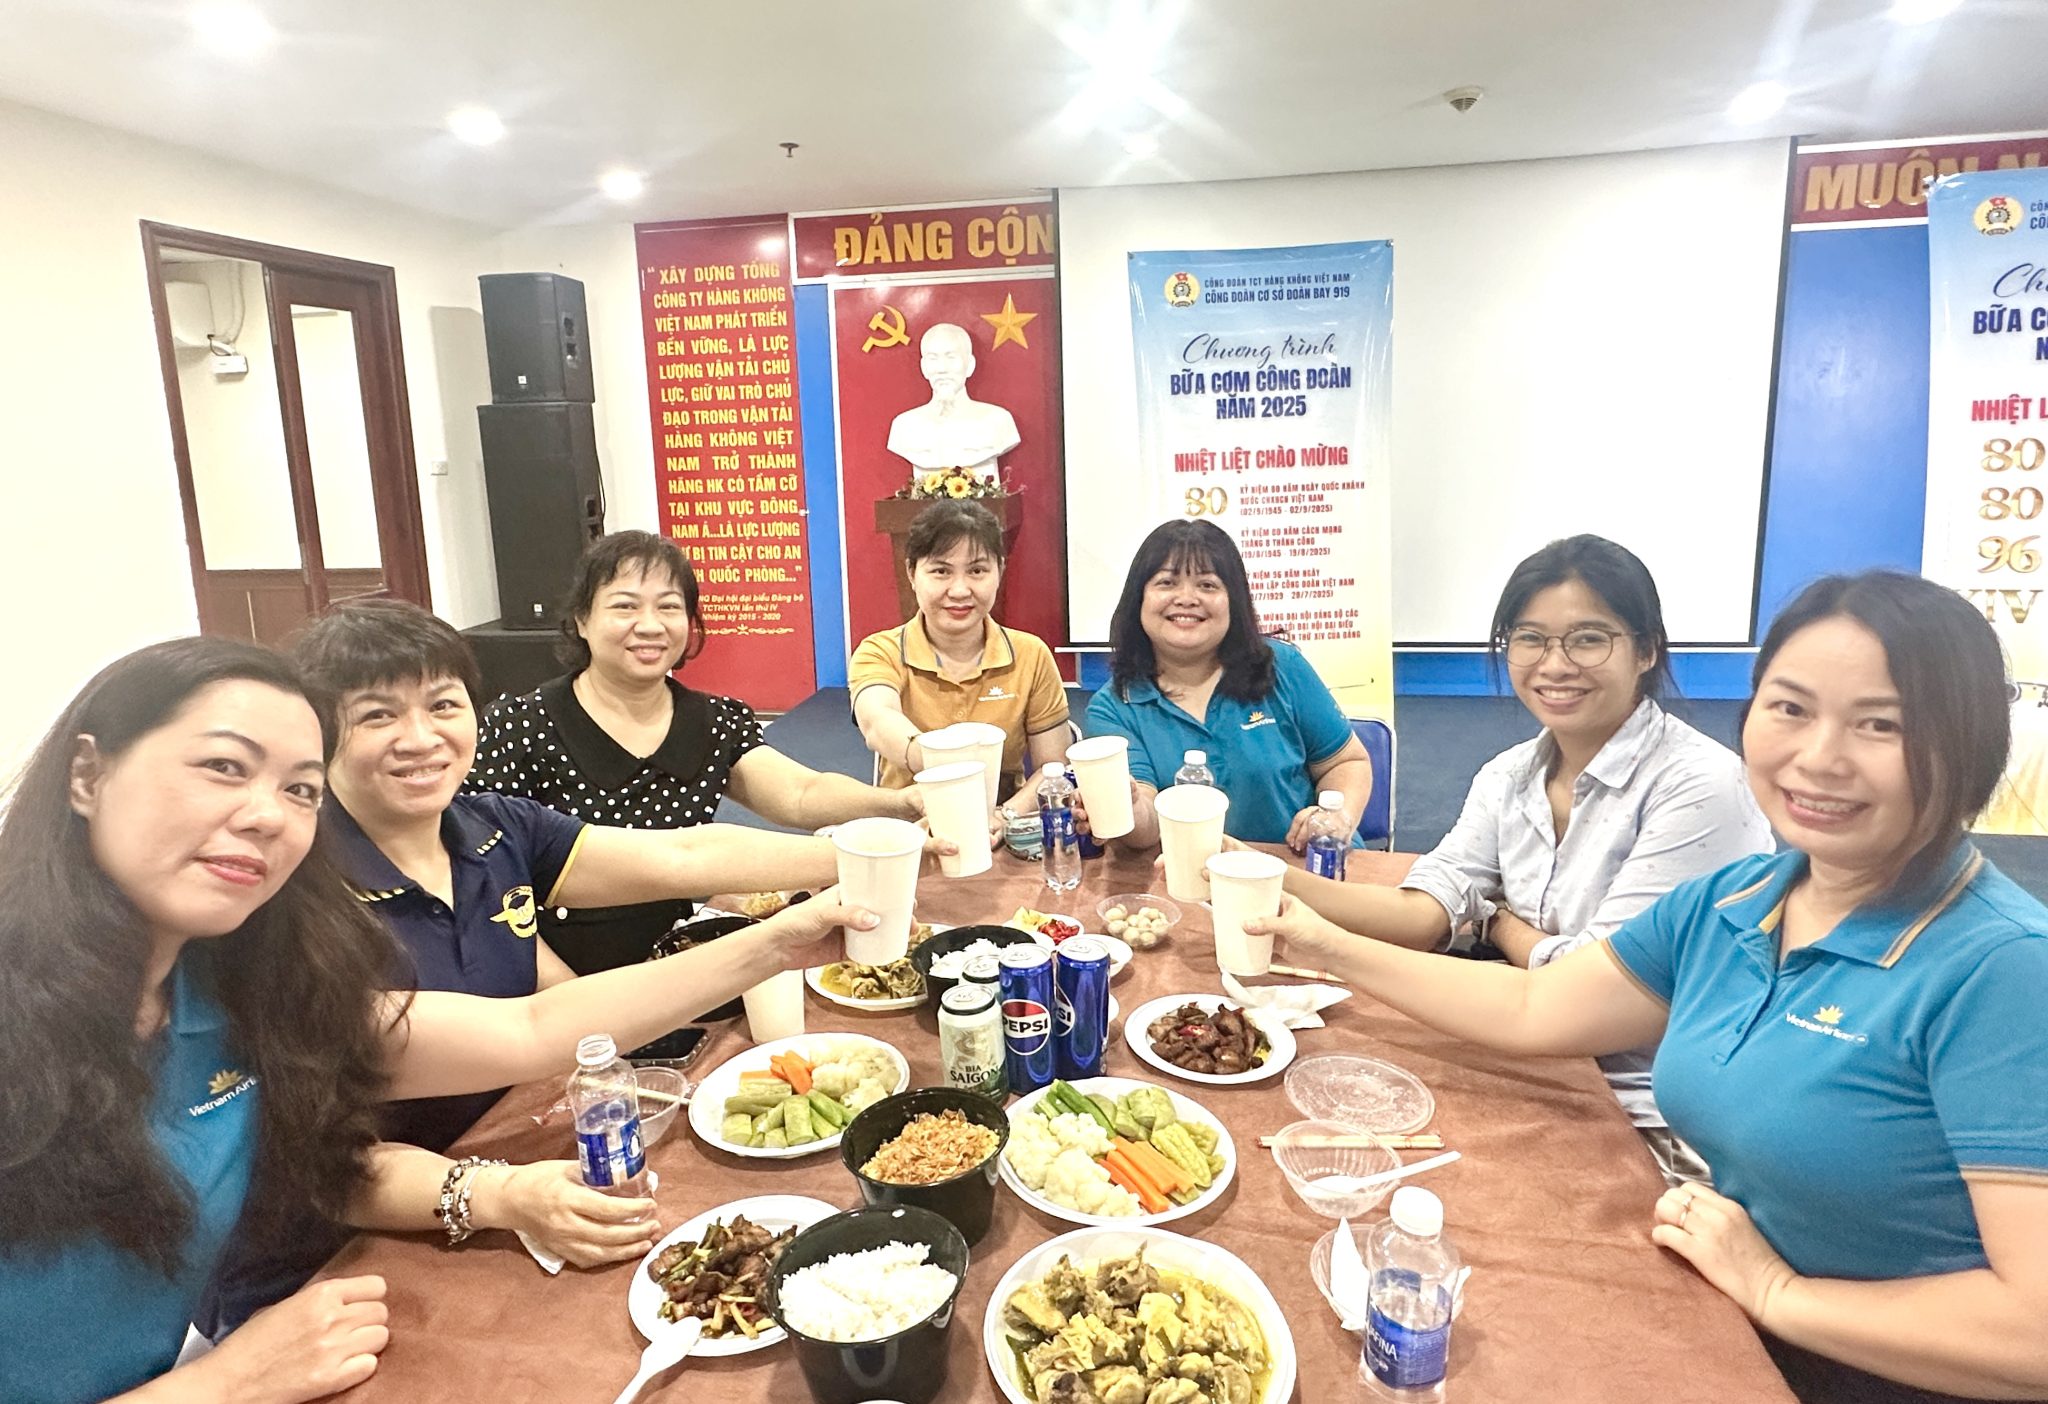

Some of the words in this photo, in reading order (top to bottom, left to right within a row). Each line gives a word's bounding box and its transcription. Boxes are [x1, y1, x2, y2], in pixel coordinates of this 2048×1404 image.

[834, 212, 953, 267] ĐẢNG
[694, 266, 735, 285] DỰNG
[1205, 277, 1224, 288] CÔNG
[1250, 277, 1261, 286] TCT
[1265, 275, 1284, 285] HÀNG
[1287, 274, 1311, 284] KHÔNG
[1315, 272, 1329, 284] VIỆT
[1333, 273, 1349, 282] NAM
[654, 290, 687, 308] CÔNG
[689, 292, 703, 306] TY
[707, 287, 740, 305] HÀNG
[744, 285, 785, 303] KHÔNG
[1206, 288, 1228, 303] CÔNG
[1258, 289, 1269, 301] CƠ
[1272, 285, 1284, 300] SỞ
[1313, 287, 1330, 299] BAY
[1334, 286, 1350, 298] 919
[655, 314, 680, 335] VIỆT
[684, 315, 712, 331] NAM
[716, 310, 747, 329] PHÁT
[751, 305, 787, 327] TRIỂN
[1973, 304, 2022, 334] BỮA
[691, 336, 732, 355] VỮNG,
[763, 335, 788, 354] LỰC
[1281, 333, 1336, 357] trình
[659, 364, 703, 382] LƯỢNG
[706, 360, 734, 380] VẬN
[737, 356, 758, 376] TẢI
[763, 354, 790, 374] CHỦ
[1170, 368, 1205, 395] BỮA
[1211, 369, 1250, 394] CƠM
[1256, 365, 1300, 391] CÔNG
[1306, 363, 1351, 389] ĐOÀN
[661, 387, 688, 405] LỰC,
[691, 384, 714, 401] GIỮ
[715, 386, 735, 400] VAI
[739, 381, 762, 399] TRÒ
[766, 378, 792, 398] CHỦ
[663, 411, 689, 429] ĐẠO
[693, 409, 737, 425] TRONG
[741, 406, 769, 425] VẬN
[771, 402, 792, 422] TẢI
[1216, 393, 1255, 419] NĂM
[1261, 395, 1306, 417] 2025
[1972, 394, 2032, 424] NHIỆT
[665, 432, 703, 448] HÀNG
[710, 428, 758, 447] KHÔNG
[764, 428, 793, 449] VIỆT
[667, 456, 700, 471] NAM
[712, 451, 739, 470] TRỞ
[748, 451, 796, 469] THÀNH
[1175, 448, 1216, 475] NHIỆT
[1222, 447, 1251, 474] LIỆT
[1256, 445, 1295, 469] CHÀO
[1301, 443, 1348, 467] MỪNG
[1981, 437, 2046, 472] 80
[669, 477, 703, 494] HÃNG
[707, 478, 724, 493] HK
[728, 475, 744, 492] CÓ
[780, 474, 797, 491] CỠ
[669, 502, 689, 519] TẠI
[695, 501, 721, 515] KHU
[728, 500, 754, 517] VỰC
[760, 496, 798, 514] ĐÔNG
[1184, 486, 1228, 516] 80
[1291, 494, 1305, 504] VIỆT
[1309, 494, 1324, 502] NAM
[1978, 487, 2044, 520] 80
[672, 524, 699, 539] NAM
[737, 522, 759, 540] LỰC
[762, 521, 800, 540] LƯỢNG
[693, 546, 705, 563] BỊ
[708, 546, 727, 560] TIN
[730, 543, 753, 563] CẬY
[757, 545, 781, 560] CHO
[784, 545, 801, 559] AN
[1977, 535, 2041, 573] 96
[709, 564, 740, 583] QUỐC
[1957, 588, 2044, 624] IV
[1002, 1019, 1048, 1033] PEPSI
[950, 1065, 999, 1083] SAIGON
[189, 1091, 236, 1116] Vietnam
